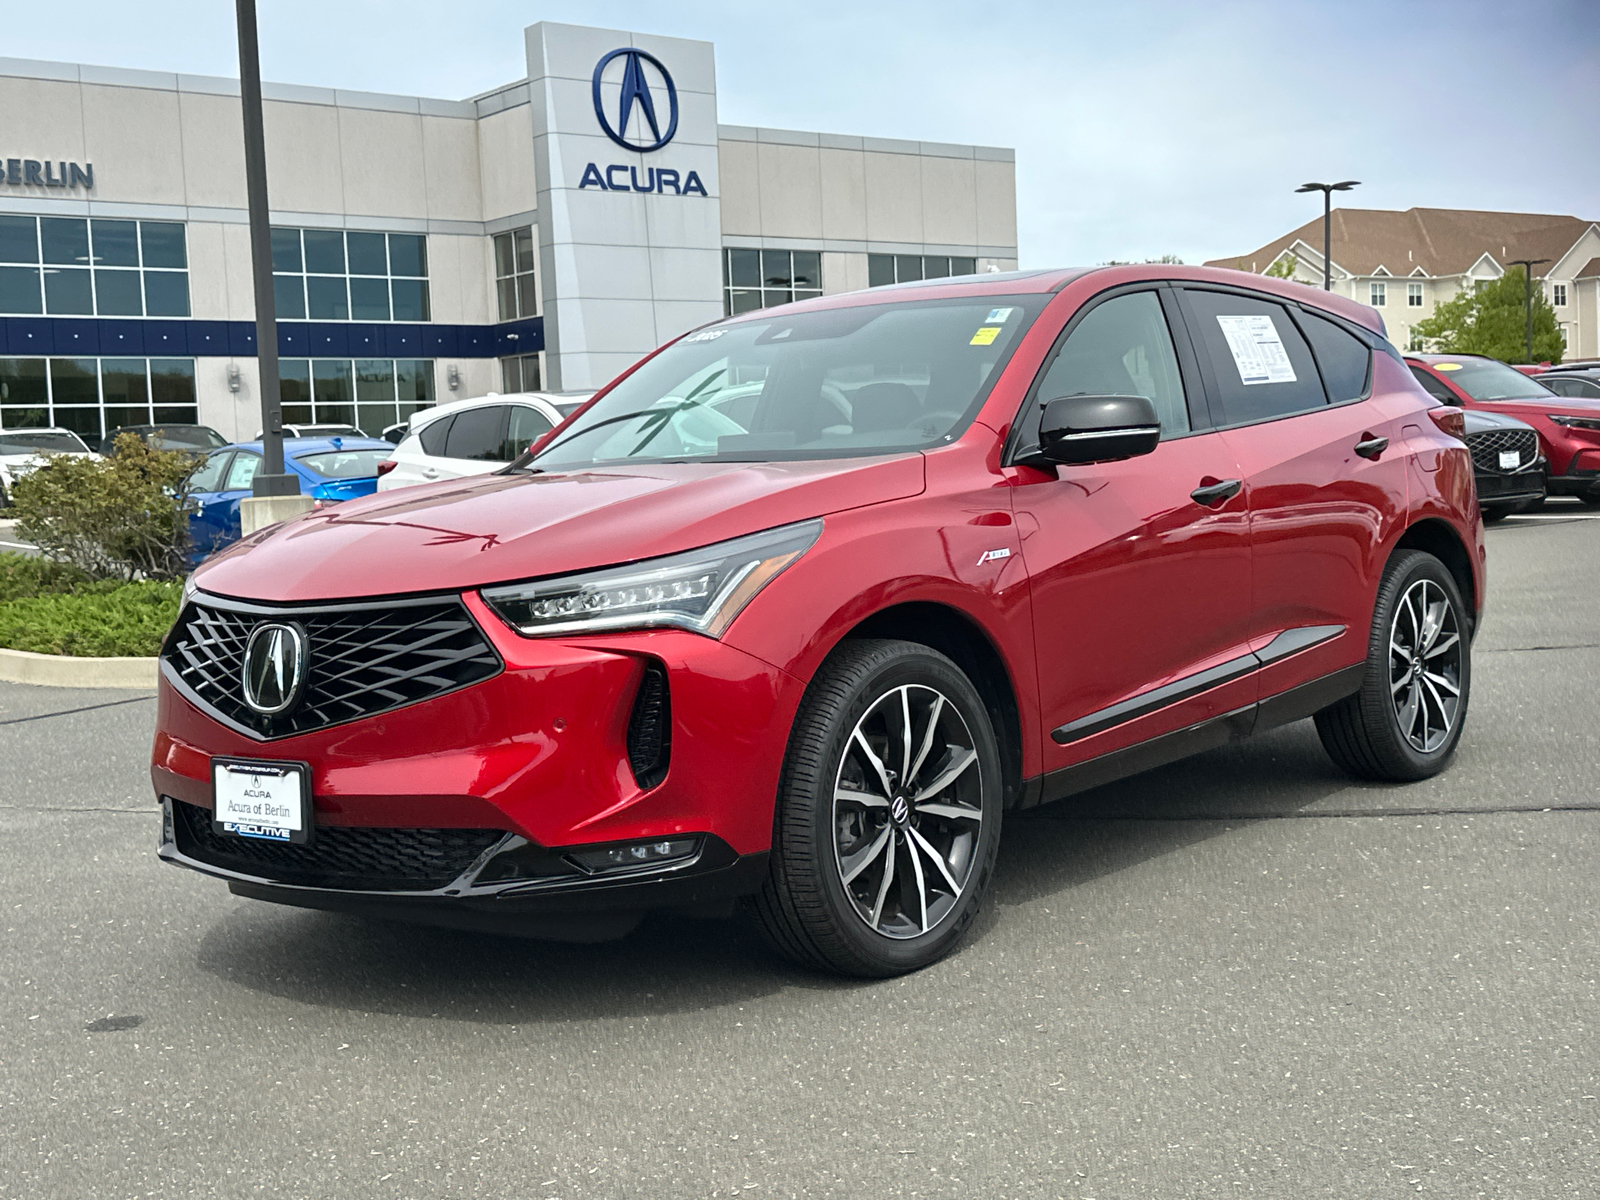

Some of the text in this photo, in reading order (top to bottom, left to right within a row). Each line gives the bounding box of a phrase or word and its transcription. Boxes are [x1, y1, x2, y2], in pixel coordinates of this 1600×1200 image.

[578, 162, 708, 197] ACURA
[243, 789, 272, 799] ACURA
[227, 799, 291, 818] Acura of Berlin
[223, 822, 291, 838] EXECUTIVE
